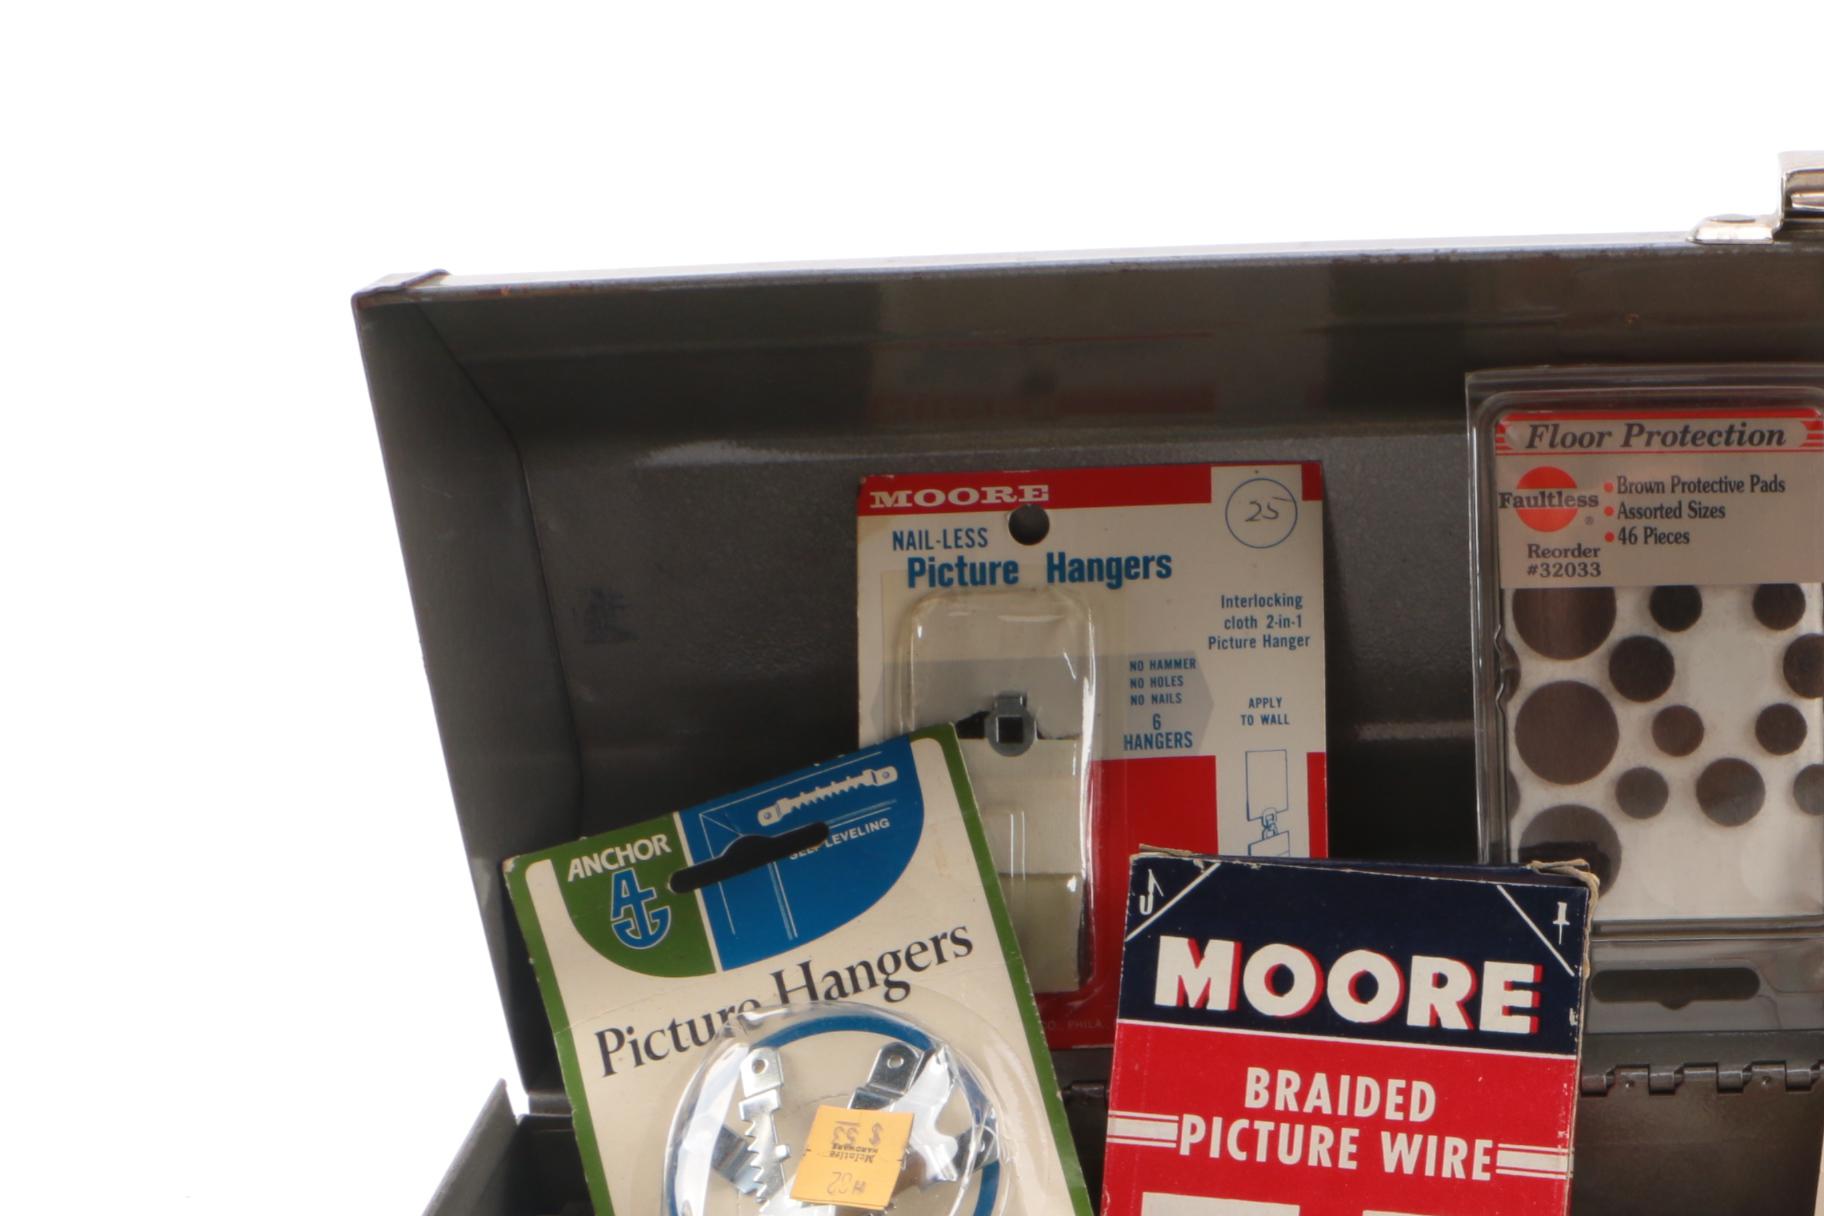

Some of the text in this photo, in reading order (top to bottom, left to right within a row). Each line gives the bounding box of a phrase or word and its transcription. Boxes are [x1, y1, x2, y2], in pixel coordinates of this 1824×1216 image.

[1525, 422, 1787, 449] Floor Protection
[1617, 475, 1785, 495] Brown Protective Pads
[870, 484, 1050, 509] MOORE
[1499, 491, 1599, 508] Faultless
[1617, 501, 1726, 520] Assorted Sizes
[893, 528, 988, 551] NAIL-LESS
[1618, 527, 1690, 545] 46 Pieces
[1527, 544, 1600, 559] Reorder
[907, 552, 1172, 589] Picture Hangers
[1527, 562, 1601, 578] #32033
[1221, 594, 1303, 609] Interlocking
[1224, 615, 1302, 629] cloth 2-in-1
[1208, 634, 1310, 650] Picture Hanger
[1129, 658, 1196, 671] NO HAMMER
[1130, 675, 1184, 688] NO HOLES
[1130, 693, 1182, 705] NO NAILS
[1248, 697, 1282, 709] APPLY
[1152, 713, 1161, 730] 6
[1241, 714, 1290, 725] TO WALL
[1124, 732, 1193, 751] HANGERS
[825, 817, 890, 848] LEVELING
[568, 833, 671, 881] ANCHOR
[1154, 934, 1543, 1034] MOORE
[595, 924, 973, 1076] Picture Hangers
[1244, 1067, 1436, 1122] BRAIDED
[1179, 1114, 1493, 1181] PICTURE WIRE
